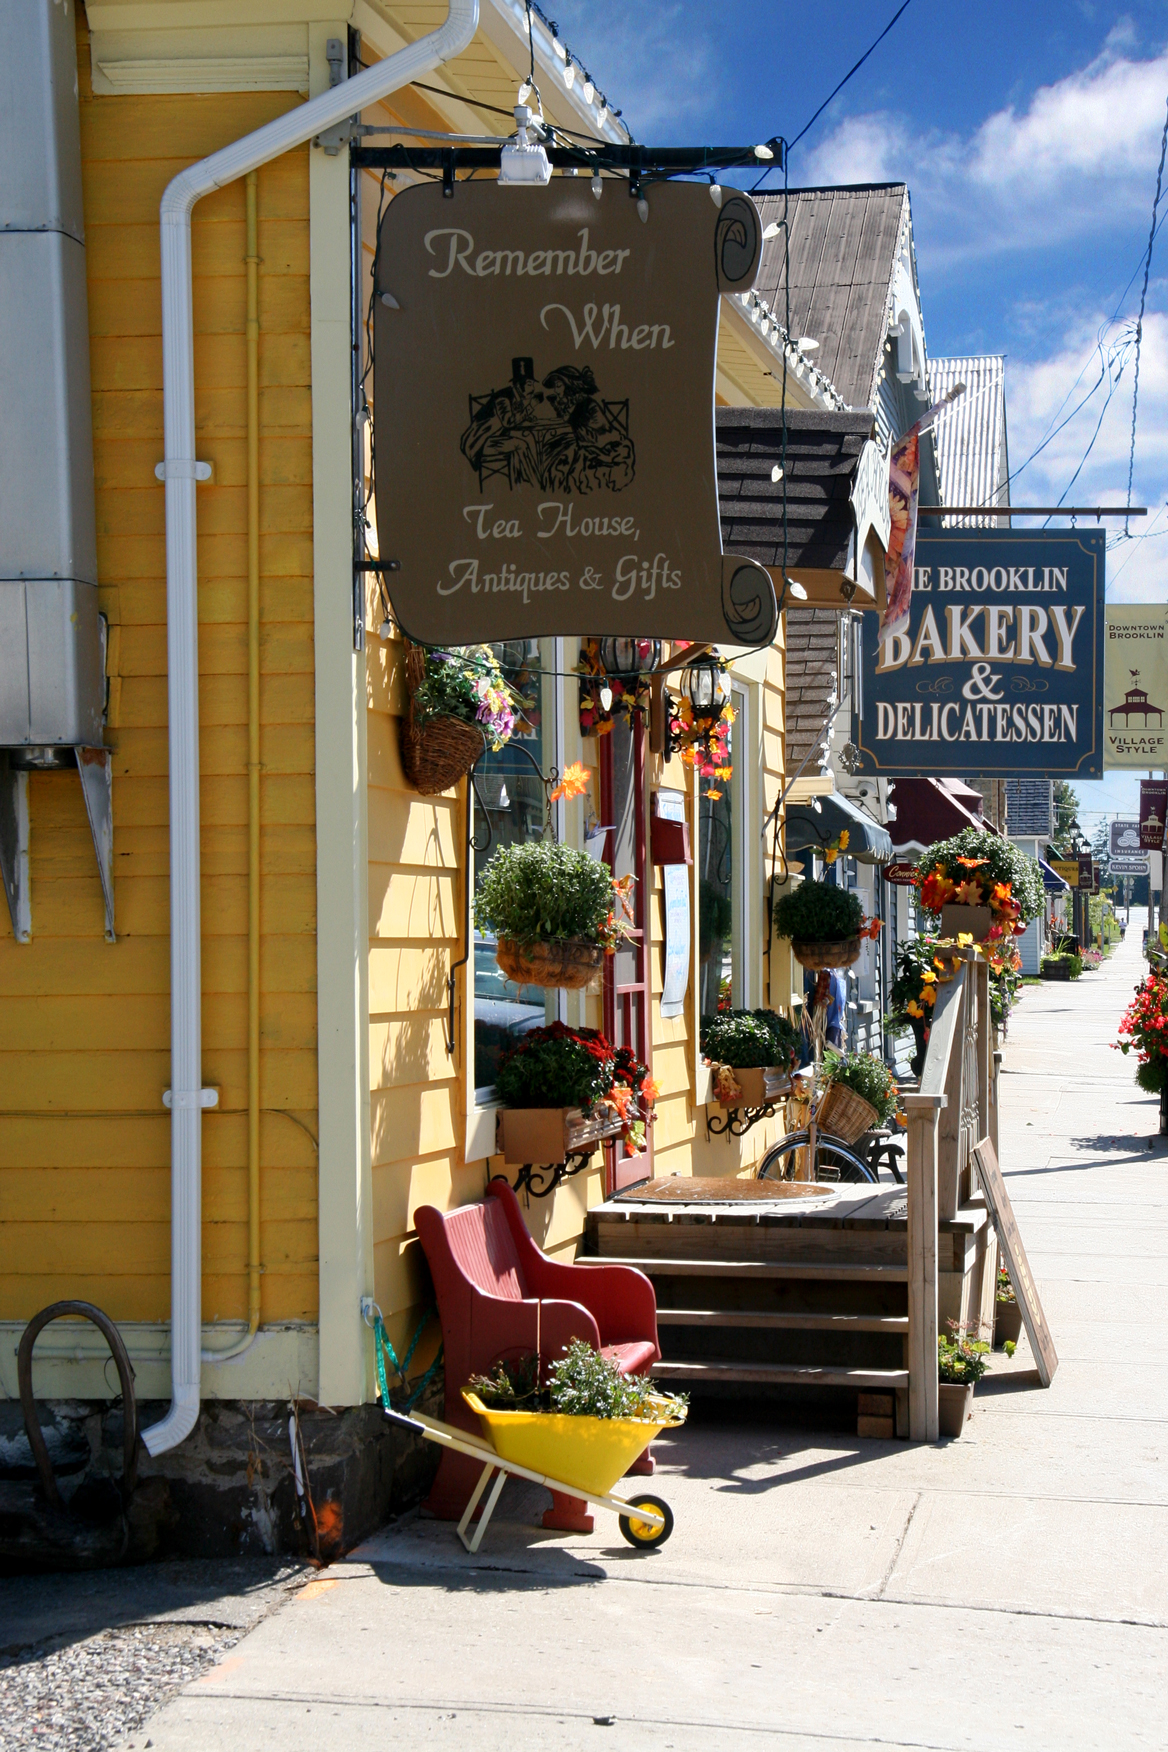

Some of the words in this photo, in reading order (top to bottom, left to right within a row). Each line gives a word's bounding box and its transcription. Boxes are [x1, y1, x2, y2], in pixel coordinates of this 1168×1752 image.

[424, 227, 631, 278] Remember
[540, 303, 675, 350] When
[463, 504, 522, 540] Tea
[537, 501, 641, 542] House,
[437, 558, 570, 603] Antiques
[579, 568, 604, 590] &
[611, 552, 682, 601] Gifts
[937, 566, 1069, 592] BROOKLIN
[875, 603, 1086, 675] BAKERY
[962, 662, 1004, 700] &
[875, 701, 1079, 743] DELICATESSEN
